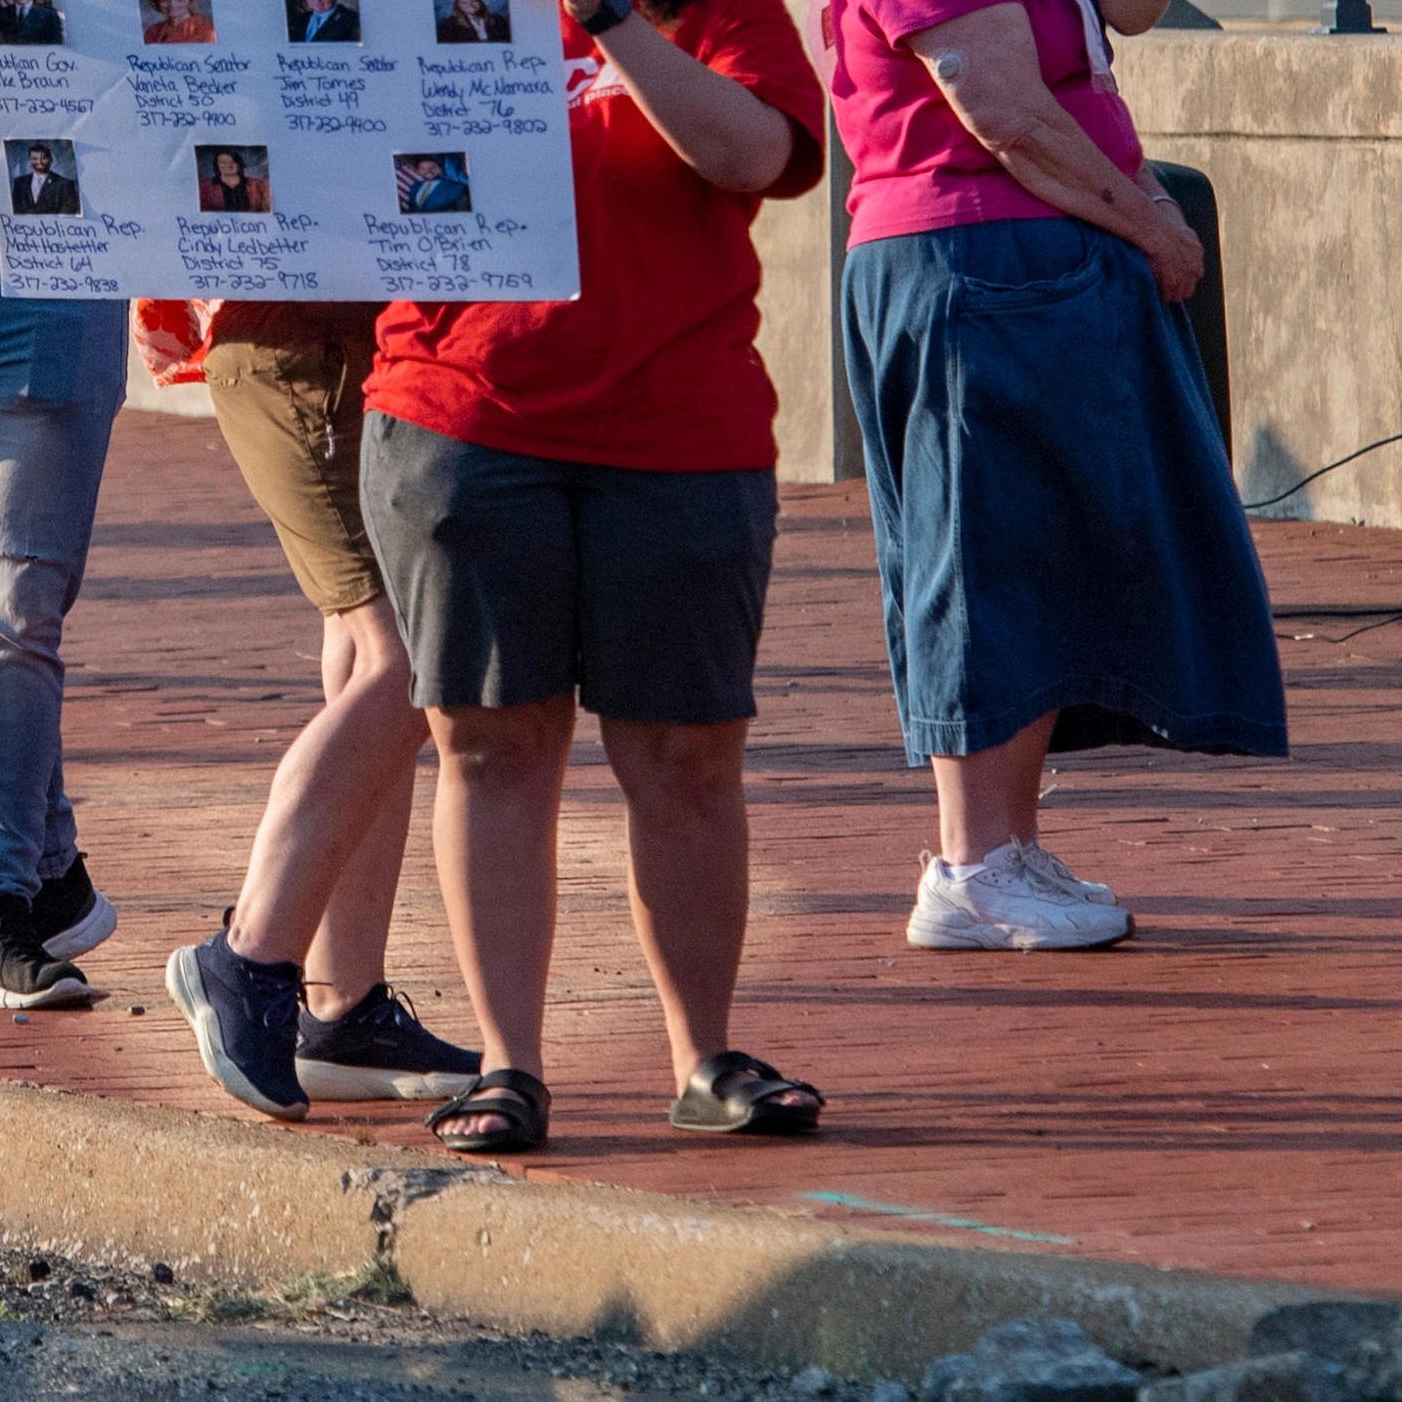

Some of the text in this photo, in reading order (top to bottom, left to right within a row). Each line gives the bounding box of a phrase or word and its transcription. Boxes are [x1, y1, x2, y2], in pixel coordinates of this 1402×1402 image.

[126, 52, 251, 77] Republican Senator
[277, 54, 350, 76] Republican
[417, 56, 494, 78] Republican
[18, 71, 69, 89] Braun
[183, 75, 238, 96] Becker
[273, 76, 366, 91] Jim Tomes
[135, 94, 215, 108] District 50
[281, 92, 359, 110] District 49
[422, 99, 514, 118] District 76
[424, 119, 548, 136] 317-232-9802
[0, 214, 145, 239] Republican Rep.
[177, 212, 319, 238] Republican Rep.
[363, 213, 527, 240] Republican Rep.
[6, 237, 41, 253] Matt
[178, 237, 309, 256] Cindy Ledbetter
[368, 238, 411, 253] Tim
[6, 255, 93, 272] District 64
[181, 255, 282, 271] District 75
[375, 254, 471, 273] District 78
[189, 270, 318, 290] 317-232-9718
